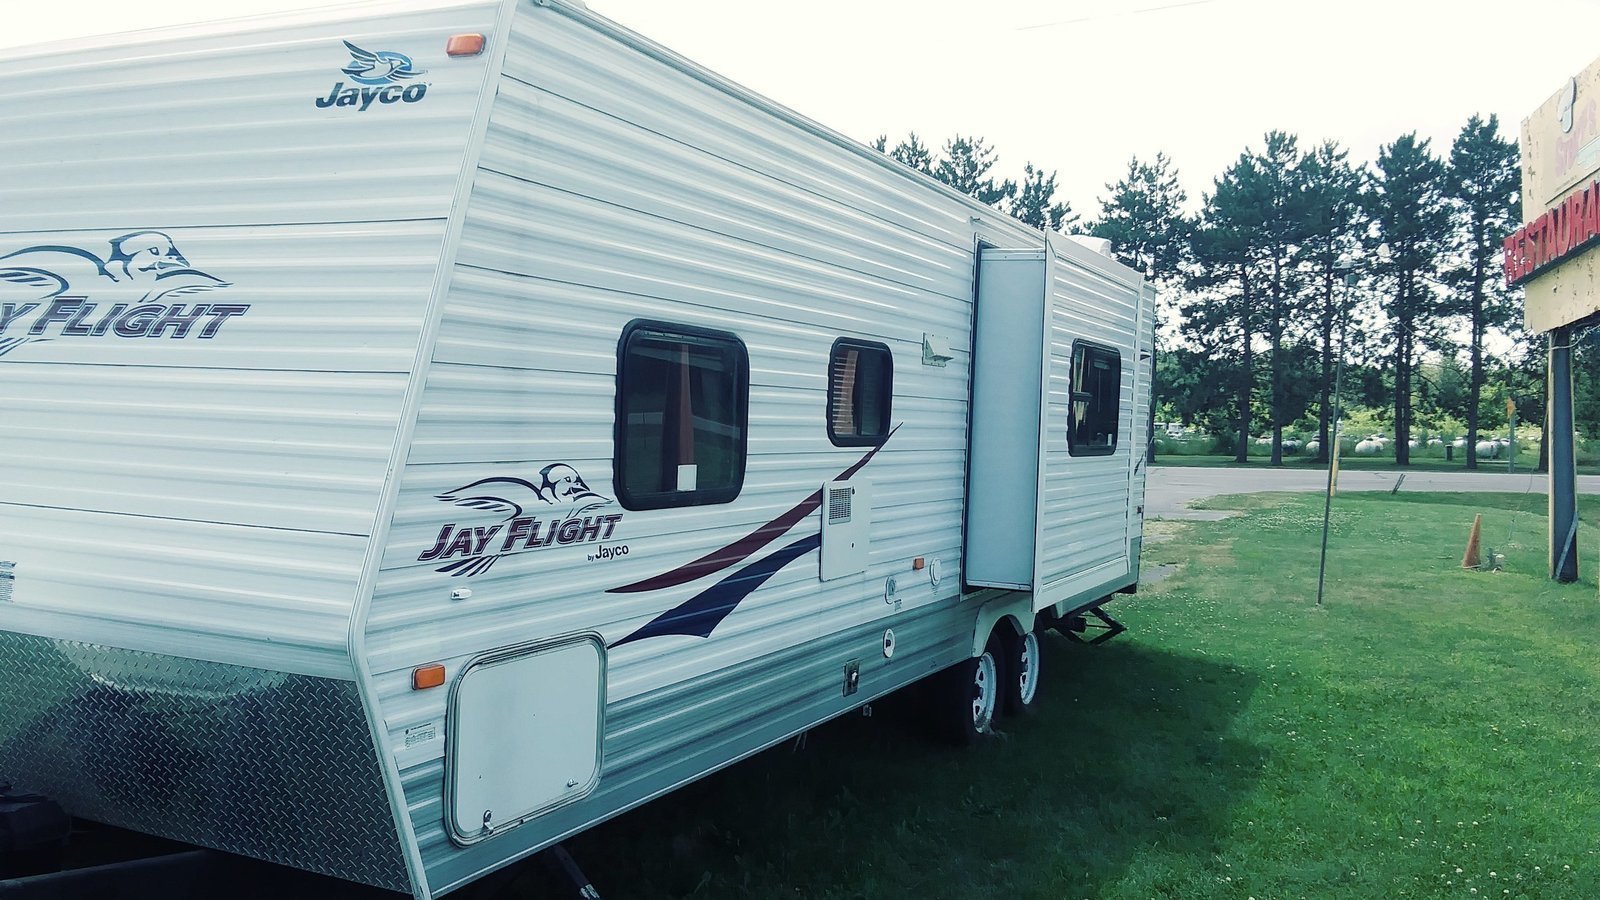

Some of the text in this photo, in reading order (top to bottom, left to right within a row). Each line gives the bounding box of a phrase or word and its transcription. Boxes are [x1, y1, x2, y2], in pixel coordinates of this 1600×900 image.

[315, 82, 427, 111] Jayco
[1504, 179, 1600, 287] RESTAURA
[27, 295, 251, 339] FLIGHT
[417, 513, 624, 561] JAY FLIGHT
[587, 544, 629, 562] by Jayco
